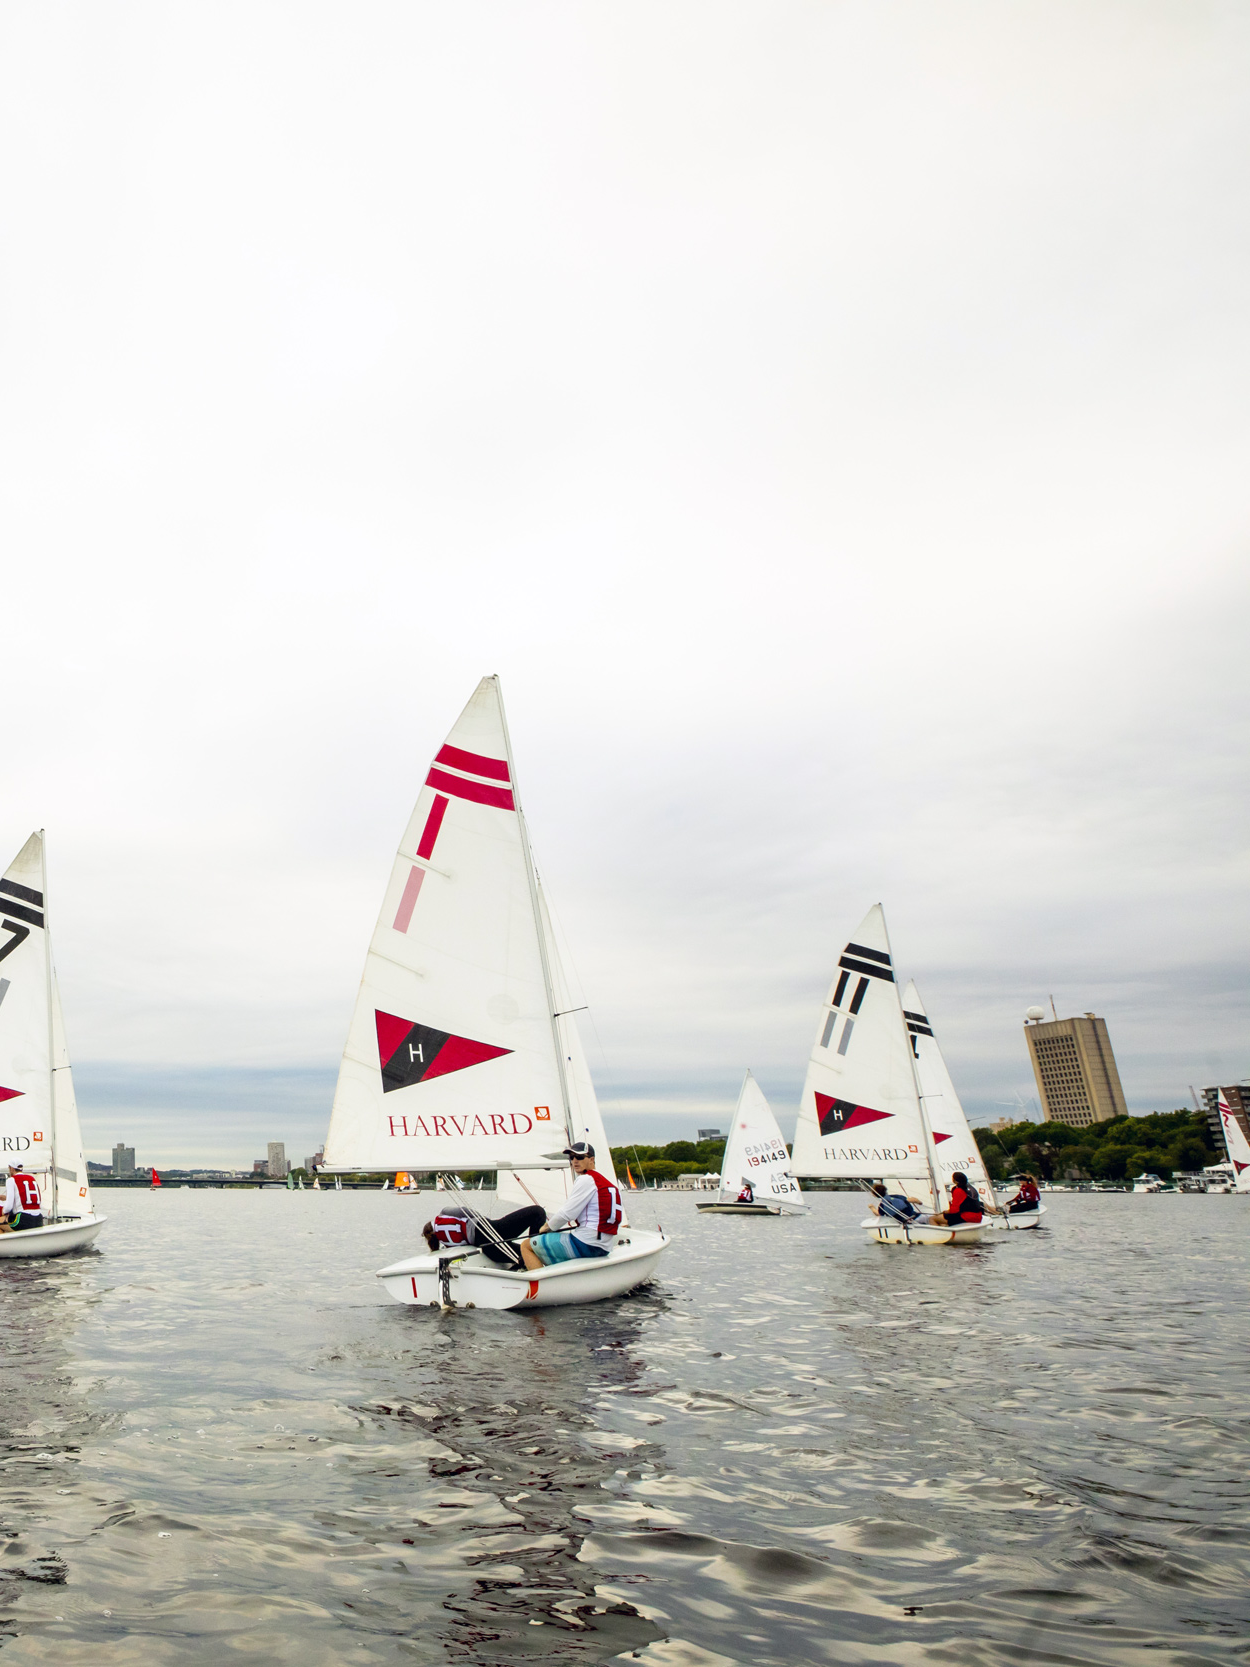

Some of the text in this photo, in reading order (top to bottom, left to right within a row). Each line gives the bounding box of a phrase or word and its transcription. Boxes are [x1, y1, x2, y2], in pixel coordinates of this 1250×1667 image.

[416, 793, 449, 861] 1
[831, 969, 871, 1016] 11
[408, 1043, 424, 1063] H
[387, 1113, 533, 1137] HARVARD
[833, 1109, 843, 1121] H
[747, 1150, 785, 1167] 194149
[824, 1147, 908, 1161] HARVARD
[23, 1180, 41, 1204] H
[771, 1182, 796, 1193] USA
[878, 1227, 889, 1239] 11
[411, 1276, 418, 1298] 1
